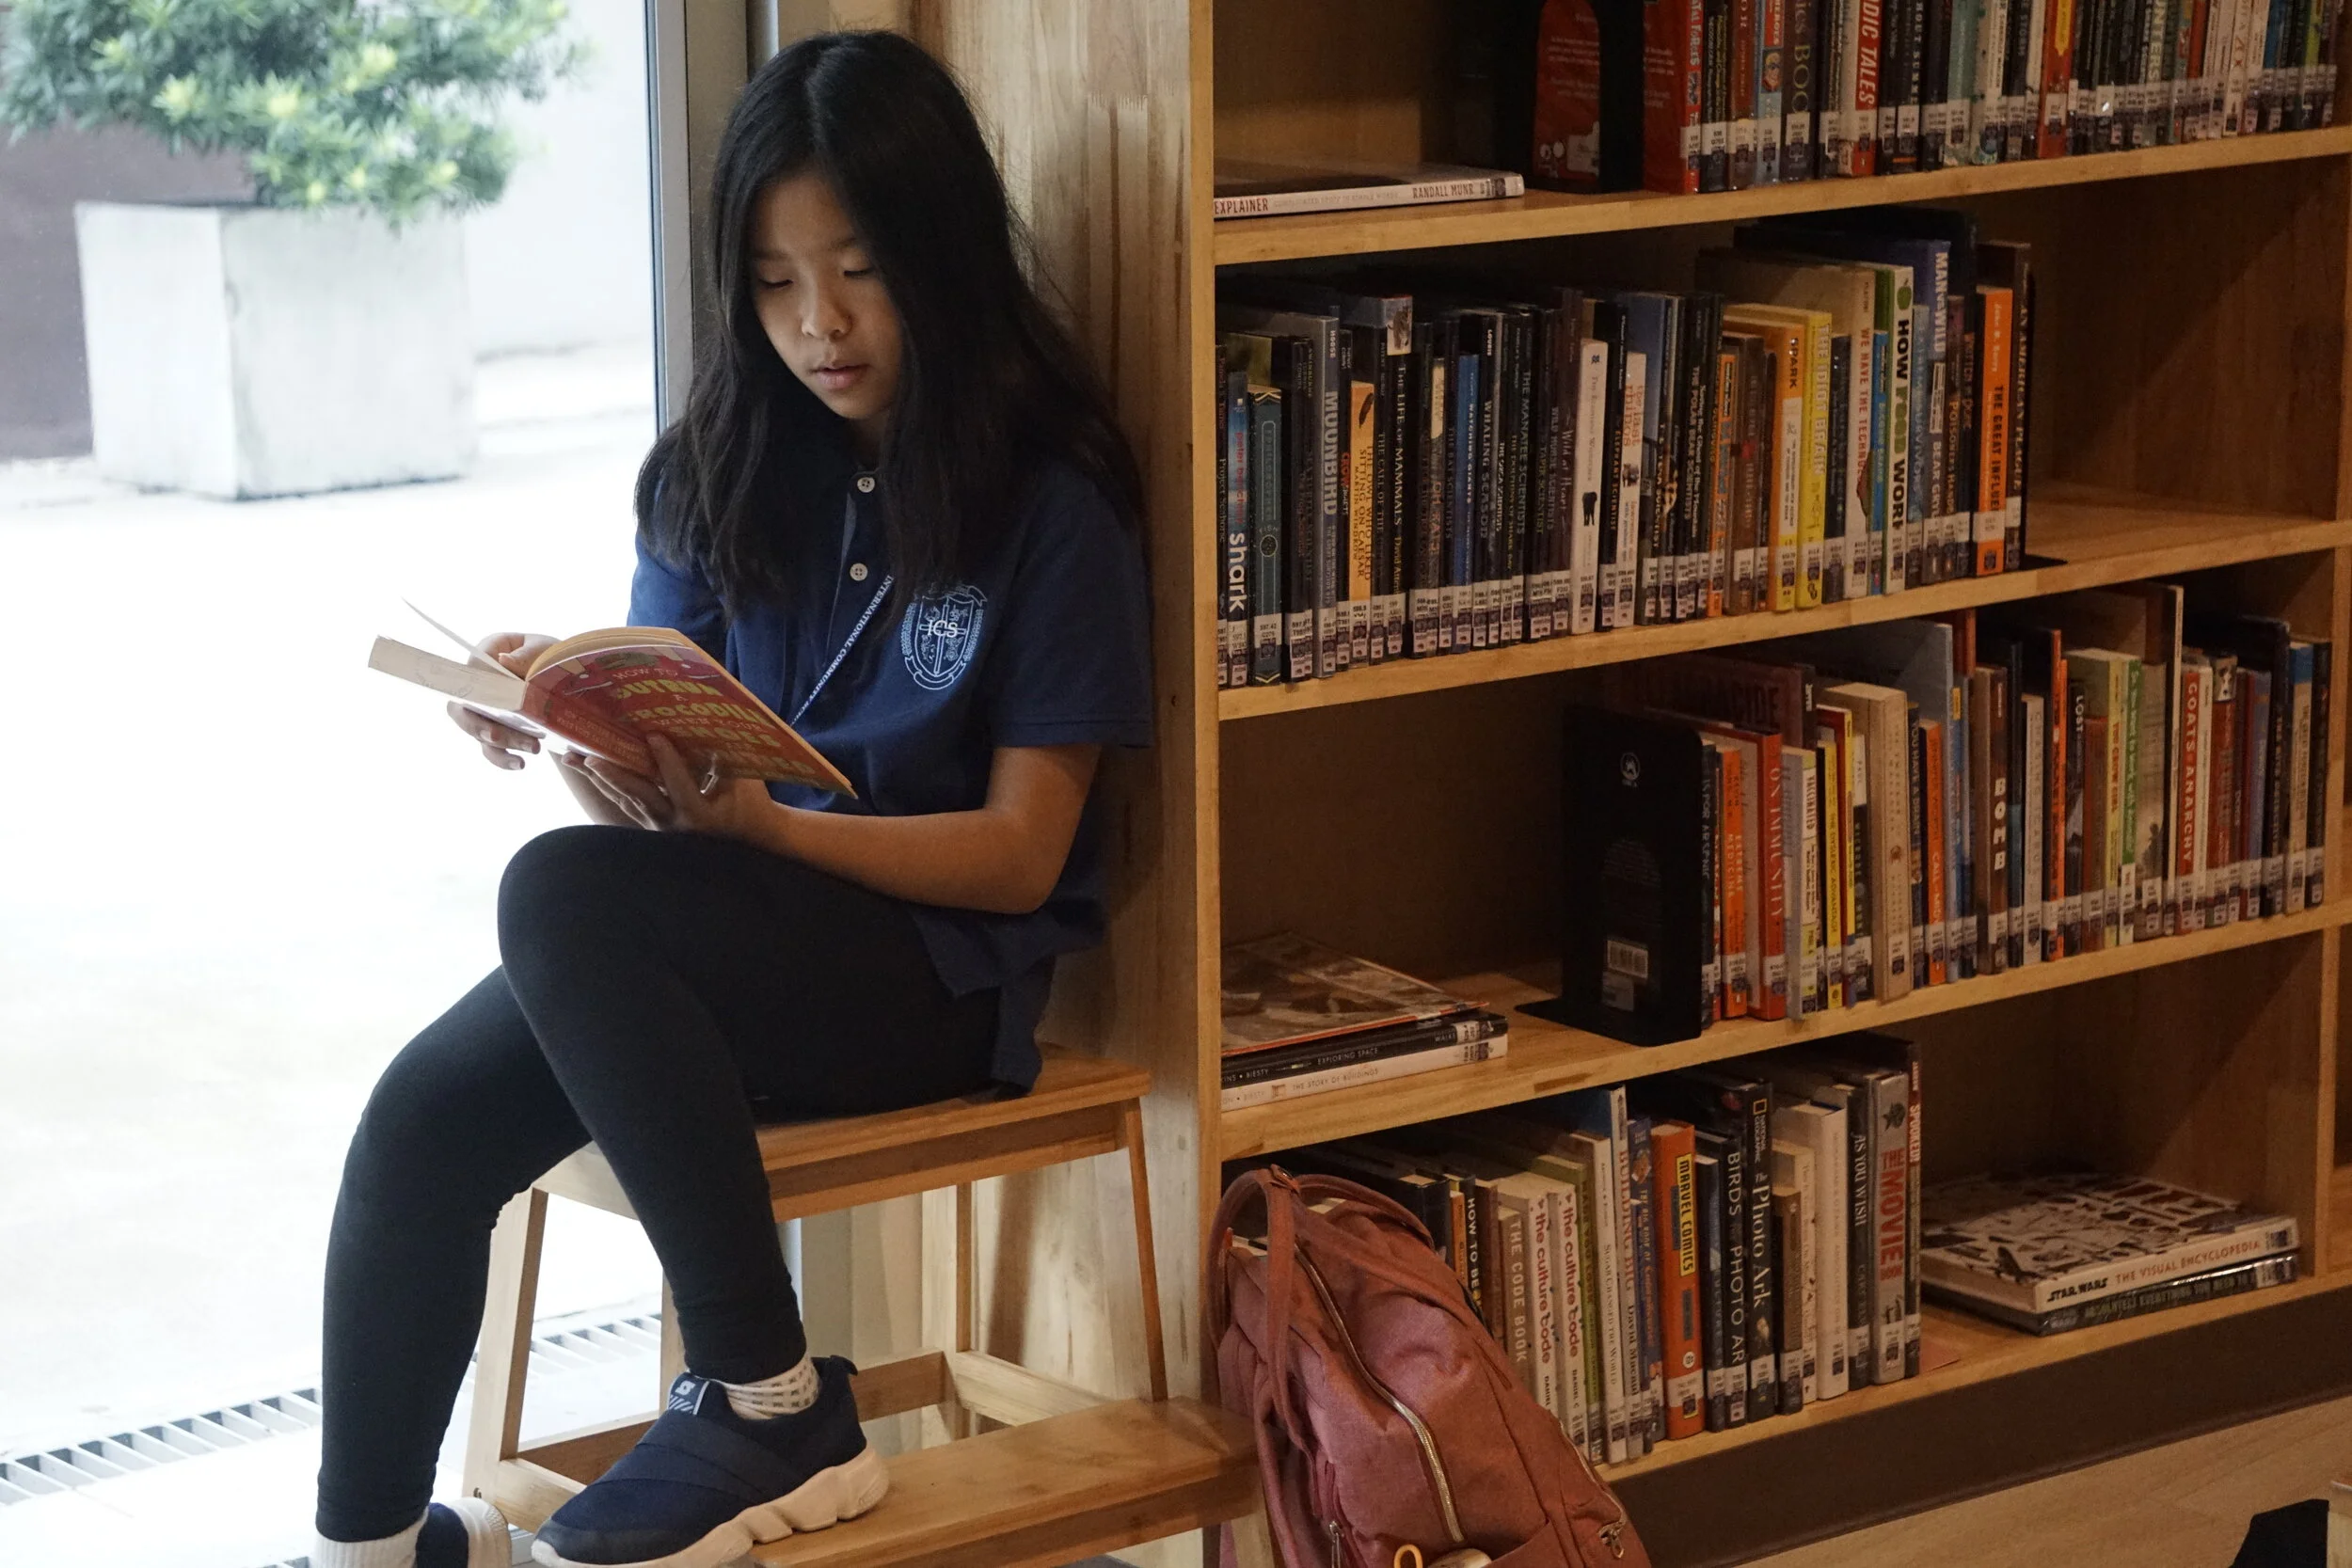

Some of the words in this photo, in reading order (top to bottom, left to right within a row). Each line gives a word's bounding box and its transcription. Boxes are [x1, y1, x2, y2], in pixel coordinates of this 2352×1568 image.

[1857, 47, 1879, 103] TALES
[1214, 198, 1269, 215] EXPLAINER
[1412, 183, 1449, 199] RANDALL
[1934, 252, 1948, 293] MAN
[1933, 309, 1947, 353] WILD
[2019, 305, 2028, 326] AN
[1814, 325, 1830, 358] THE
[1860, 327, 1870, 351] WE
[1896, 320, 1910, 380] HOW
[1397, 365, 1407, 391] THE
[1521, 371, 1533, 401] THE
[1789, 338, 1799, 389] SPARK
[1859, 354, 1869, 385] HAVE
[2016, 331, 2027, 420] AMERICAN
[1396, 394, 1406, 425] LIFE
[1814, 365, 1828, 411] IDIOT
[1858, 390, 1869, 413] THE
[1994, 385, 2004, 409] THE
[1467, 404, 1475, 460] WATCHING
[1482, 401, 1493, 467] WHALING
[1518, 403, 1531, 461] MANATEE
[1624, 385, 1637, 447] rhinos
[1633, 412, 1645, 447] last
[1894, 386, 1908, 454] FOOD
[1992, 415, 2003, 455] GREAT
[1323, 390, 1340, 516] MOONBIRD
[1562, 429, 1575, 455] Wild
[1613, 429, 1622, 482] ELEPHANT
[1812, 418, 1827, 476] BRAIN
[1932, 440, 1943, 480] BEAR
[2013, 426, 2025, 491] PLAGUE
[1217, 458, 1228, 491] Project
[1340, 452, 1351, 487] CROW
[1358, 450, 1367, 501] SITTING
[1393, 447, 1406, 527] MAMMALS
[1516, 465, 1528, 535] SCIENTISTS
[1558, 476, 1574, 510] Heart
[1610, 483, 1619, 531] SCIENTIST
[1358, 510, 1366, 527] ON
[1229, 532, 1248, 613] shark
[1357, 530, 1366, 578] CAESAR
[847, 575, 894, 646] INTERNATIONAL
[927, 619, 959, 639] ICS
[809, 648, 848, 702] COMMUNITY
[2075, 695, 2084, 734] LOST
[2185, 681, 2199, 752] GOATS
[1770, 768, 1782, 798] ON
[1805, 776, 1817, 830] VACCINATED
[2182, 765, 2197, 863] ANARCHY
[1735, 833, 1743, 893] EXTREME
[1770, 807, 1783, 917] IMMUNITY
[1931, 852, 1941, 885] CALL
[1317, 1050, 1357, 1066] EXPLORING
[1358, 1046, 1379, 1059] SPACE
[1293, 1082, 1306, 1092] THE
[1307, 1077, 1329, 1089] STORY
[1343, 1068, 1380, 1083] BUILDINGS
[1849, 1132, 1867, 1153] AS
[1909, 1102, 1921, 1164] SPOOKED!
[1677, 1160, 1692, 1216] MARVEL
[1726, 1151, 1741, 1216] BIRDS
[1853, 1153, 1867, 1183] YOU
[1467, 1197, 1478, 1235] HOW
[1563, 1207, 1575, 1237] the
[1618, 1149, 1634, 1250] BUILDING
[1751, 1184, 1772, 1259] Photo
[1853, 1183, 1867, 1227] WISH
[1879, 1167, 1904, 1265] MOVIE
[1509, 1219, 1522, 1256] THE
[1535, 1213, 1547, 1243] the
[1680, 1221, 1694, 1272] COMICS
[1469, 1241, 1479, 1262] TO
[1564, 1241, 1578, 1306] culture
[1624, 1257, 1636, 1291] BIG
[2046, 1286, 2078, 1303] STAR
[2077, 1277, 2109, 1293] WARS
[2115, 1271, 2137, 1284] THE
[2139, 1261, 2176, 1279] VISUAL
[2179, 1240, 2260, 1269] ENCYCLOPEDIA
[1470, 1267, 1480, 1289] BE
[1511, 1261, 1525, 1308] CODE
[1536, 1247, 1551, 1312] culture
[1729, 1244, 1744, 1326] PHOTO
[1752, 1263, 1772, 1309] Ark
[1515, 1314, 1528, 1362] BOOK
[1540, 1313, 1553, 1364] code
[1567, 1307, 1581, 1357] code
[1628, 1304, 1638, 1344] David
[1609, 1346, 1619, 1385] WORLD
[1731, 1335, 1745, 1365] AR
[1571, 1370, 1580, 1400] DANIEL
